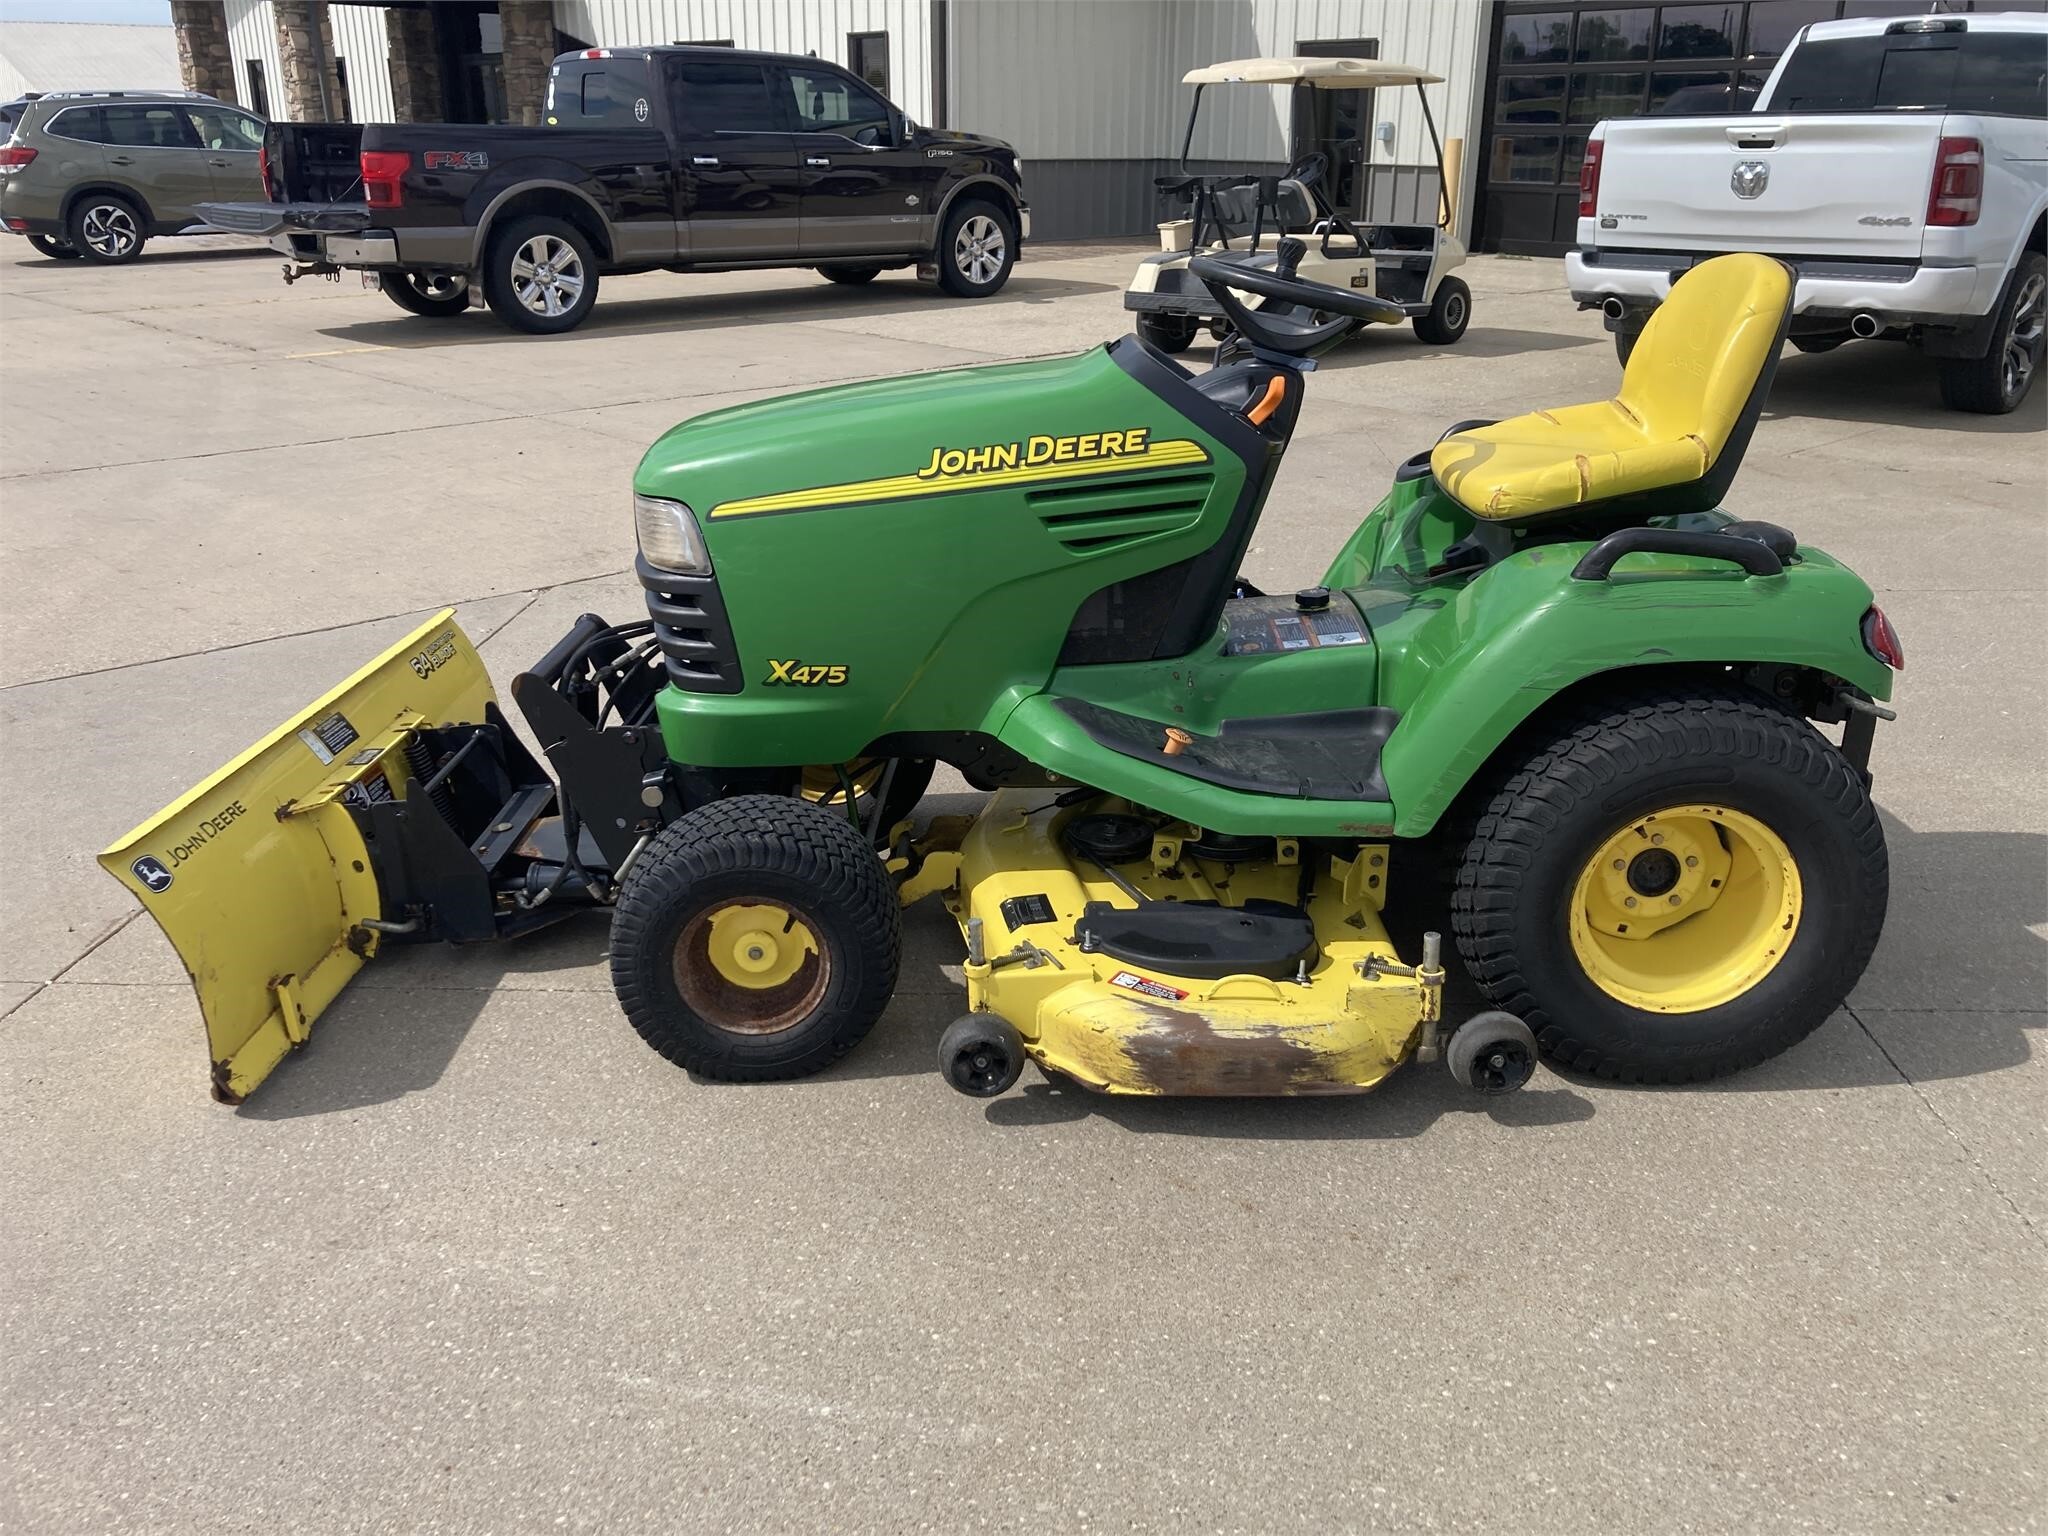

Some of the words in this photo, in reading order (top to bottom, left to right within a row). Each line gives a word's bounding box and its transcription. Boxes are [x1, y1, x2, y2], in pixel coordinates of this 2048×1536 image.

[424, 152, 489, 169] FX4
[918, 443, 1022, 478] JOHN
[1025, 428, 1151, 466] DEERE
[410, 652, 435, 679] 54
[763, 659, 848, 686] X475
[166, 832, 208, 868] JOHN
[199, 800, 247, 839] DEERE
